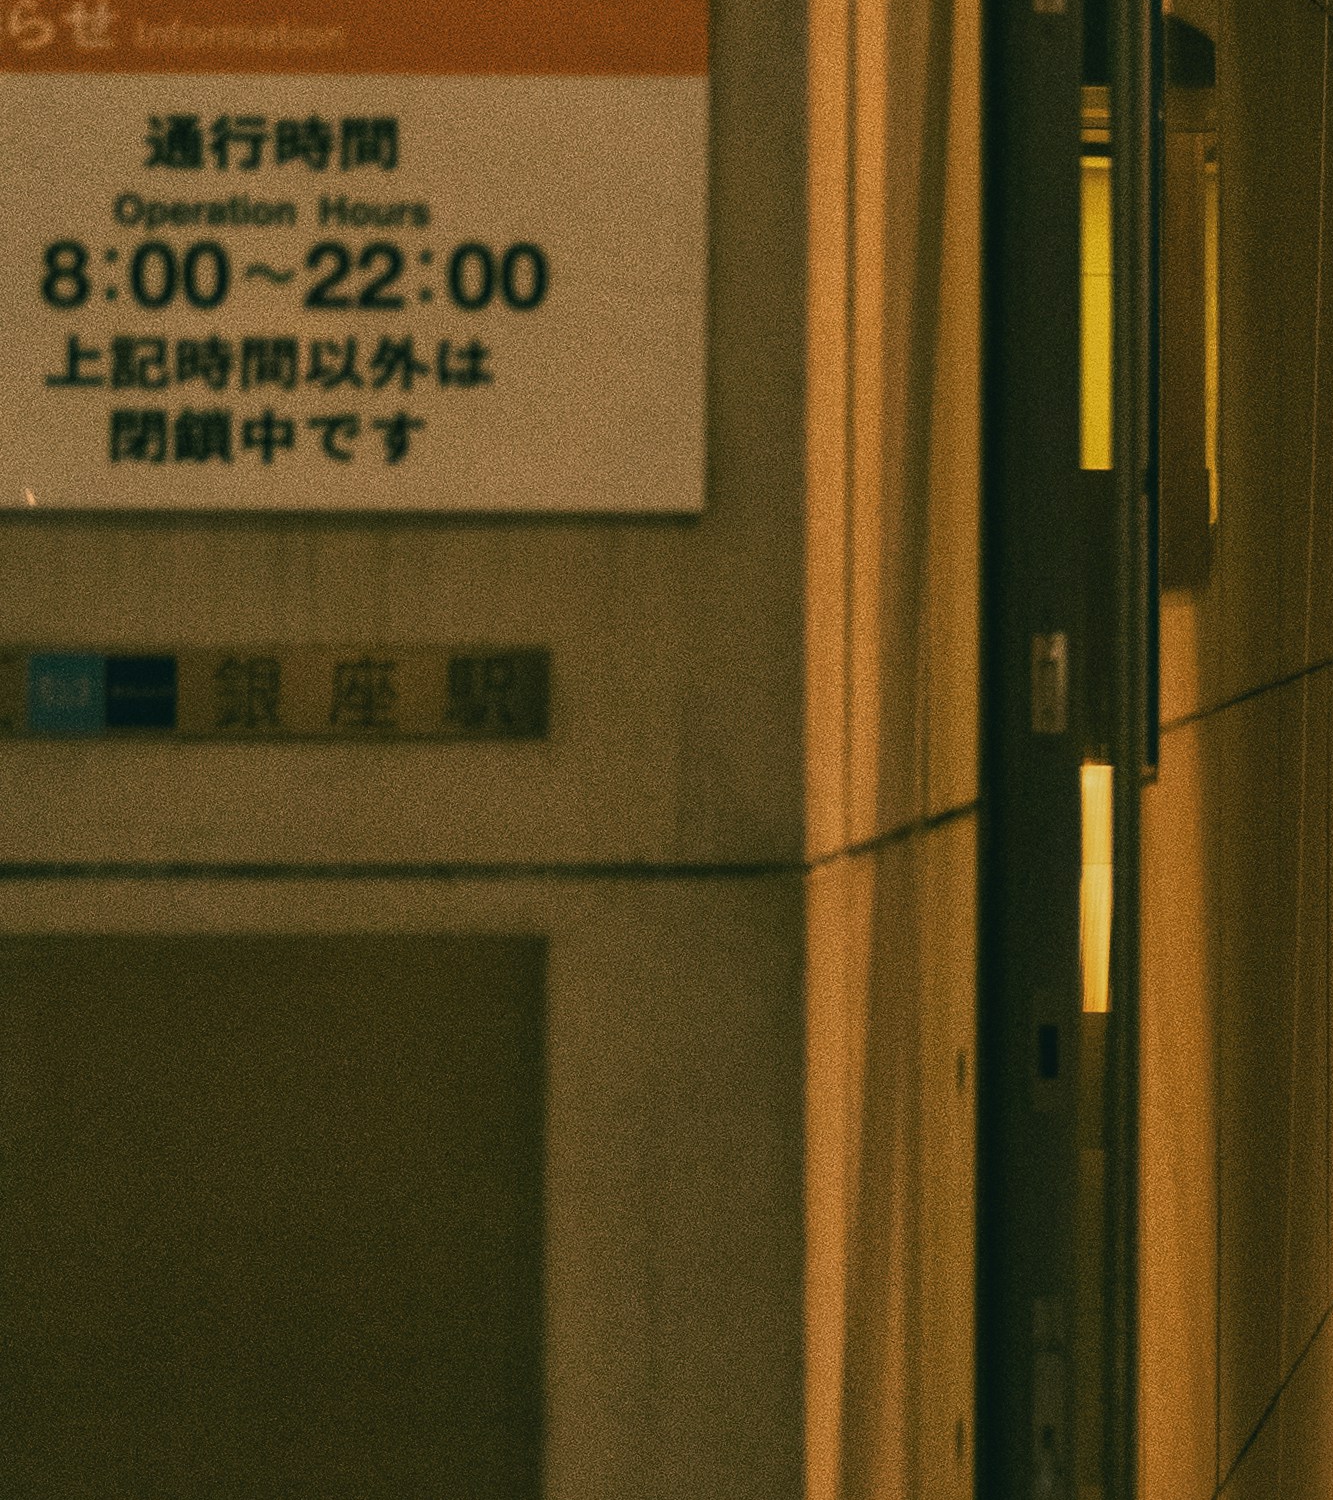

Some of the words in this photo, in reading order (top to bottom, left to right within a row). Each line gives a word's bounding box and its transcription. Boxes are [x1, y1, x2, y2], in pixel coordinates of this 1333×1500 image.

[145, 113, 400, 172] 通行時間
[113, 194, 296, 229] Operation
[319, 195, 431, 228] Hours
[45, 335, 493, 391] 上記時間以外は
[109, 408, 426, 465] 閉鎖中です
